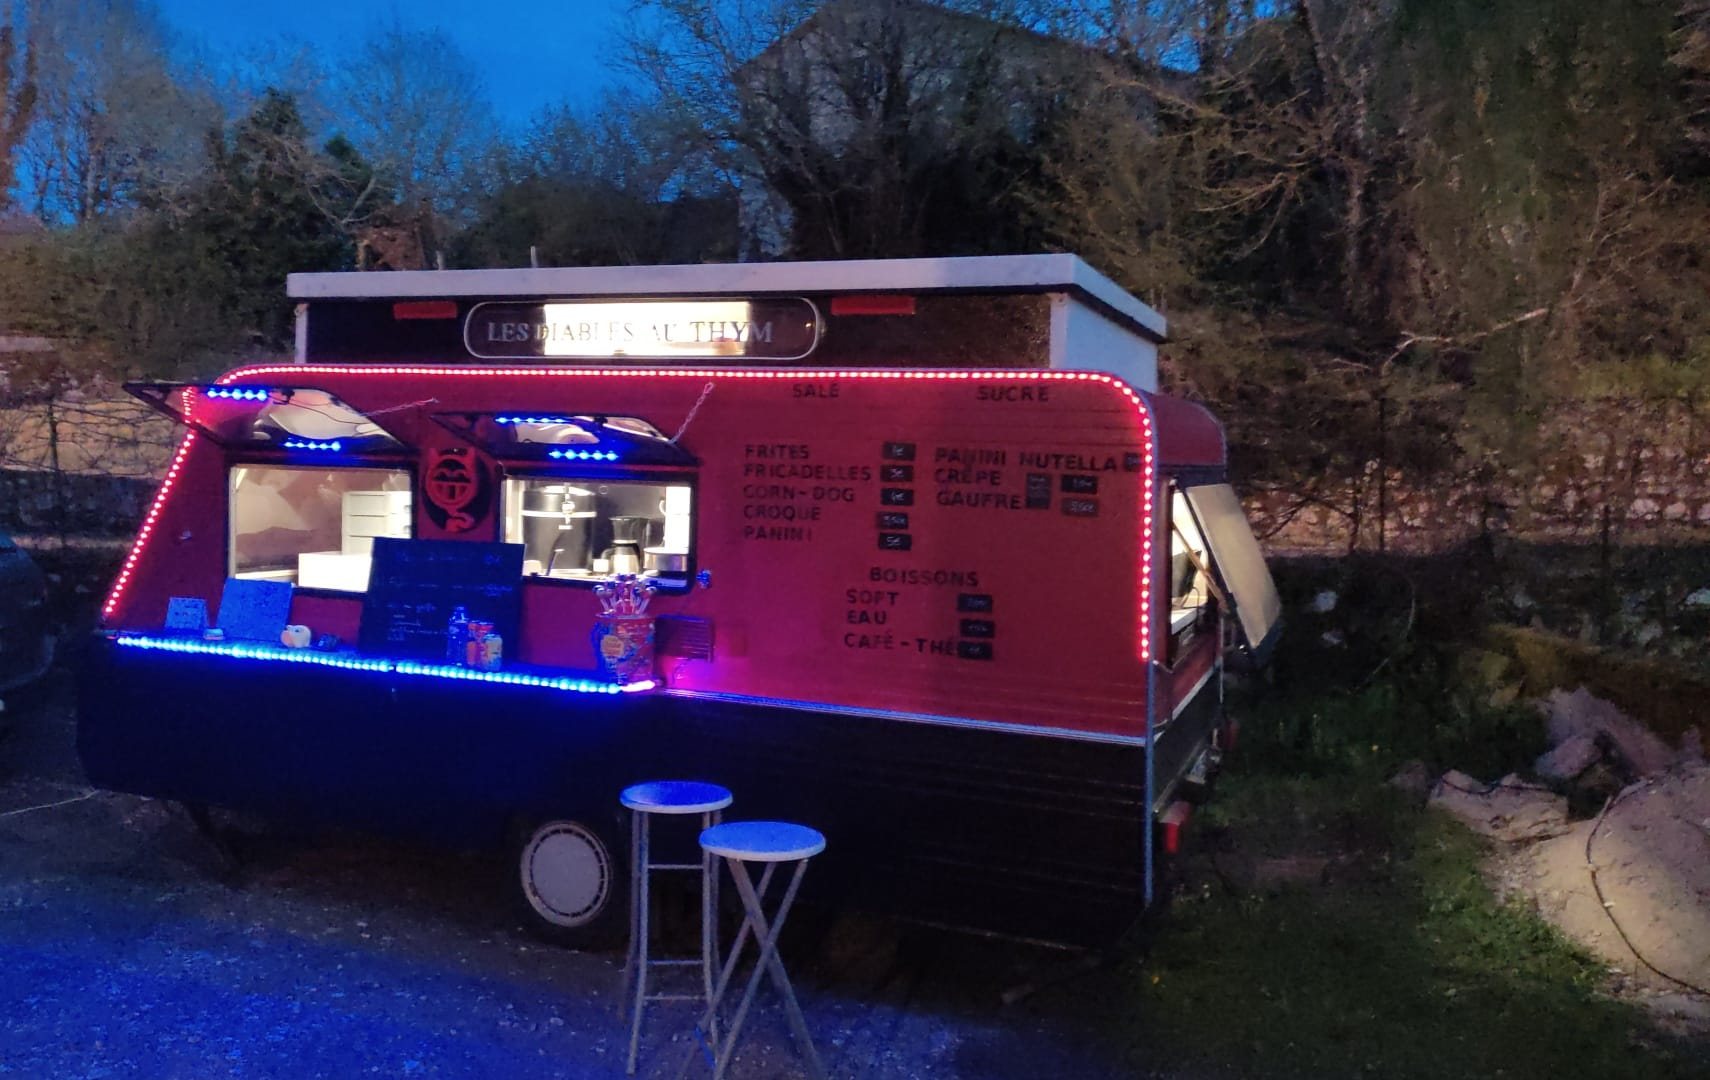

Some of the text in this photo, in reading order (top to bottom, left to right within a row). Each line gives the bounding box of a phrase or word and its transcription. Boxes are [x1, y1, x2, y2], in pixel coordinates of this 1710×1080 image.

[487, 321, 530, 342] LES
[689, 320, 774, 343] THYM
[744, 443, 809, 460] FRITES
[1019, 450, 1118, 473] NUTELLA
[743, 463, 872, 482] FRICADELLES
[936, 490, 1022, 510] GAUFRE
[743, 503, 822, 522] CROQUE
[743, 524, 813, 543] PANINI
[869, 566, 980, 587] BOISSONS
[846, 588, 900, 606] SOFT
[847, 609, 888, 626] EAU
